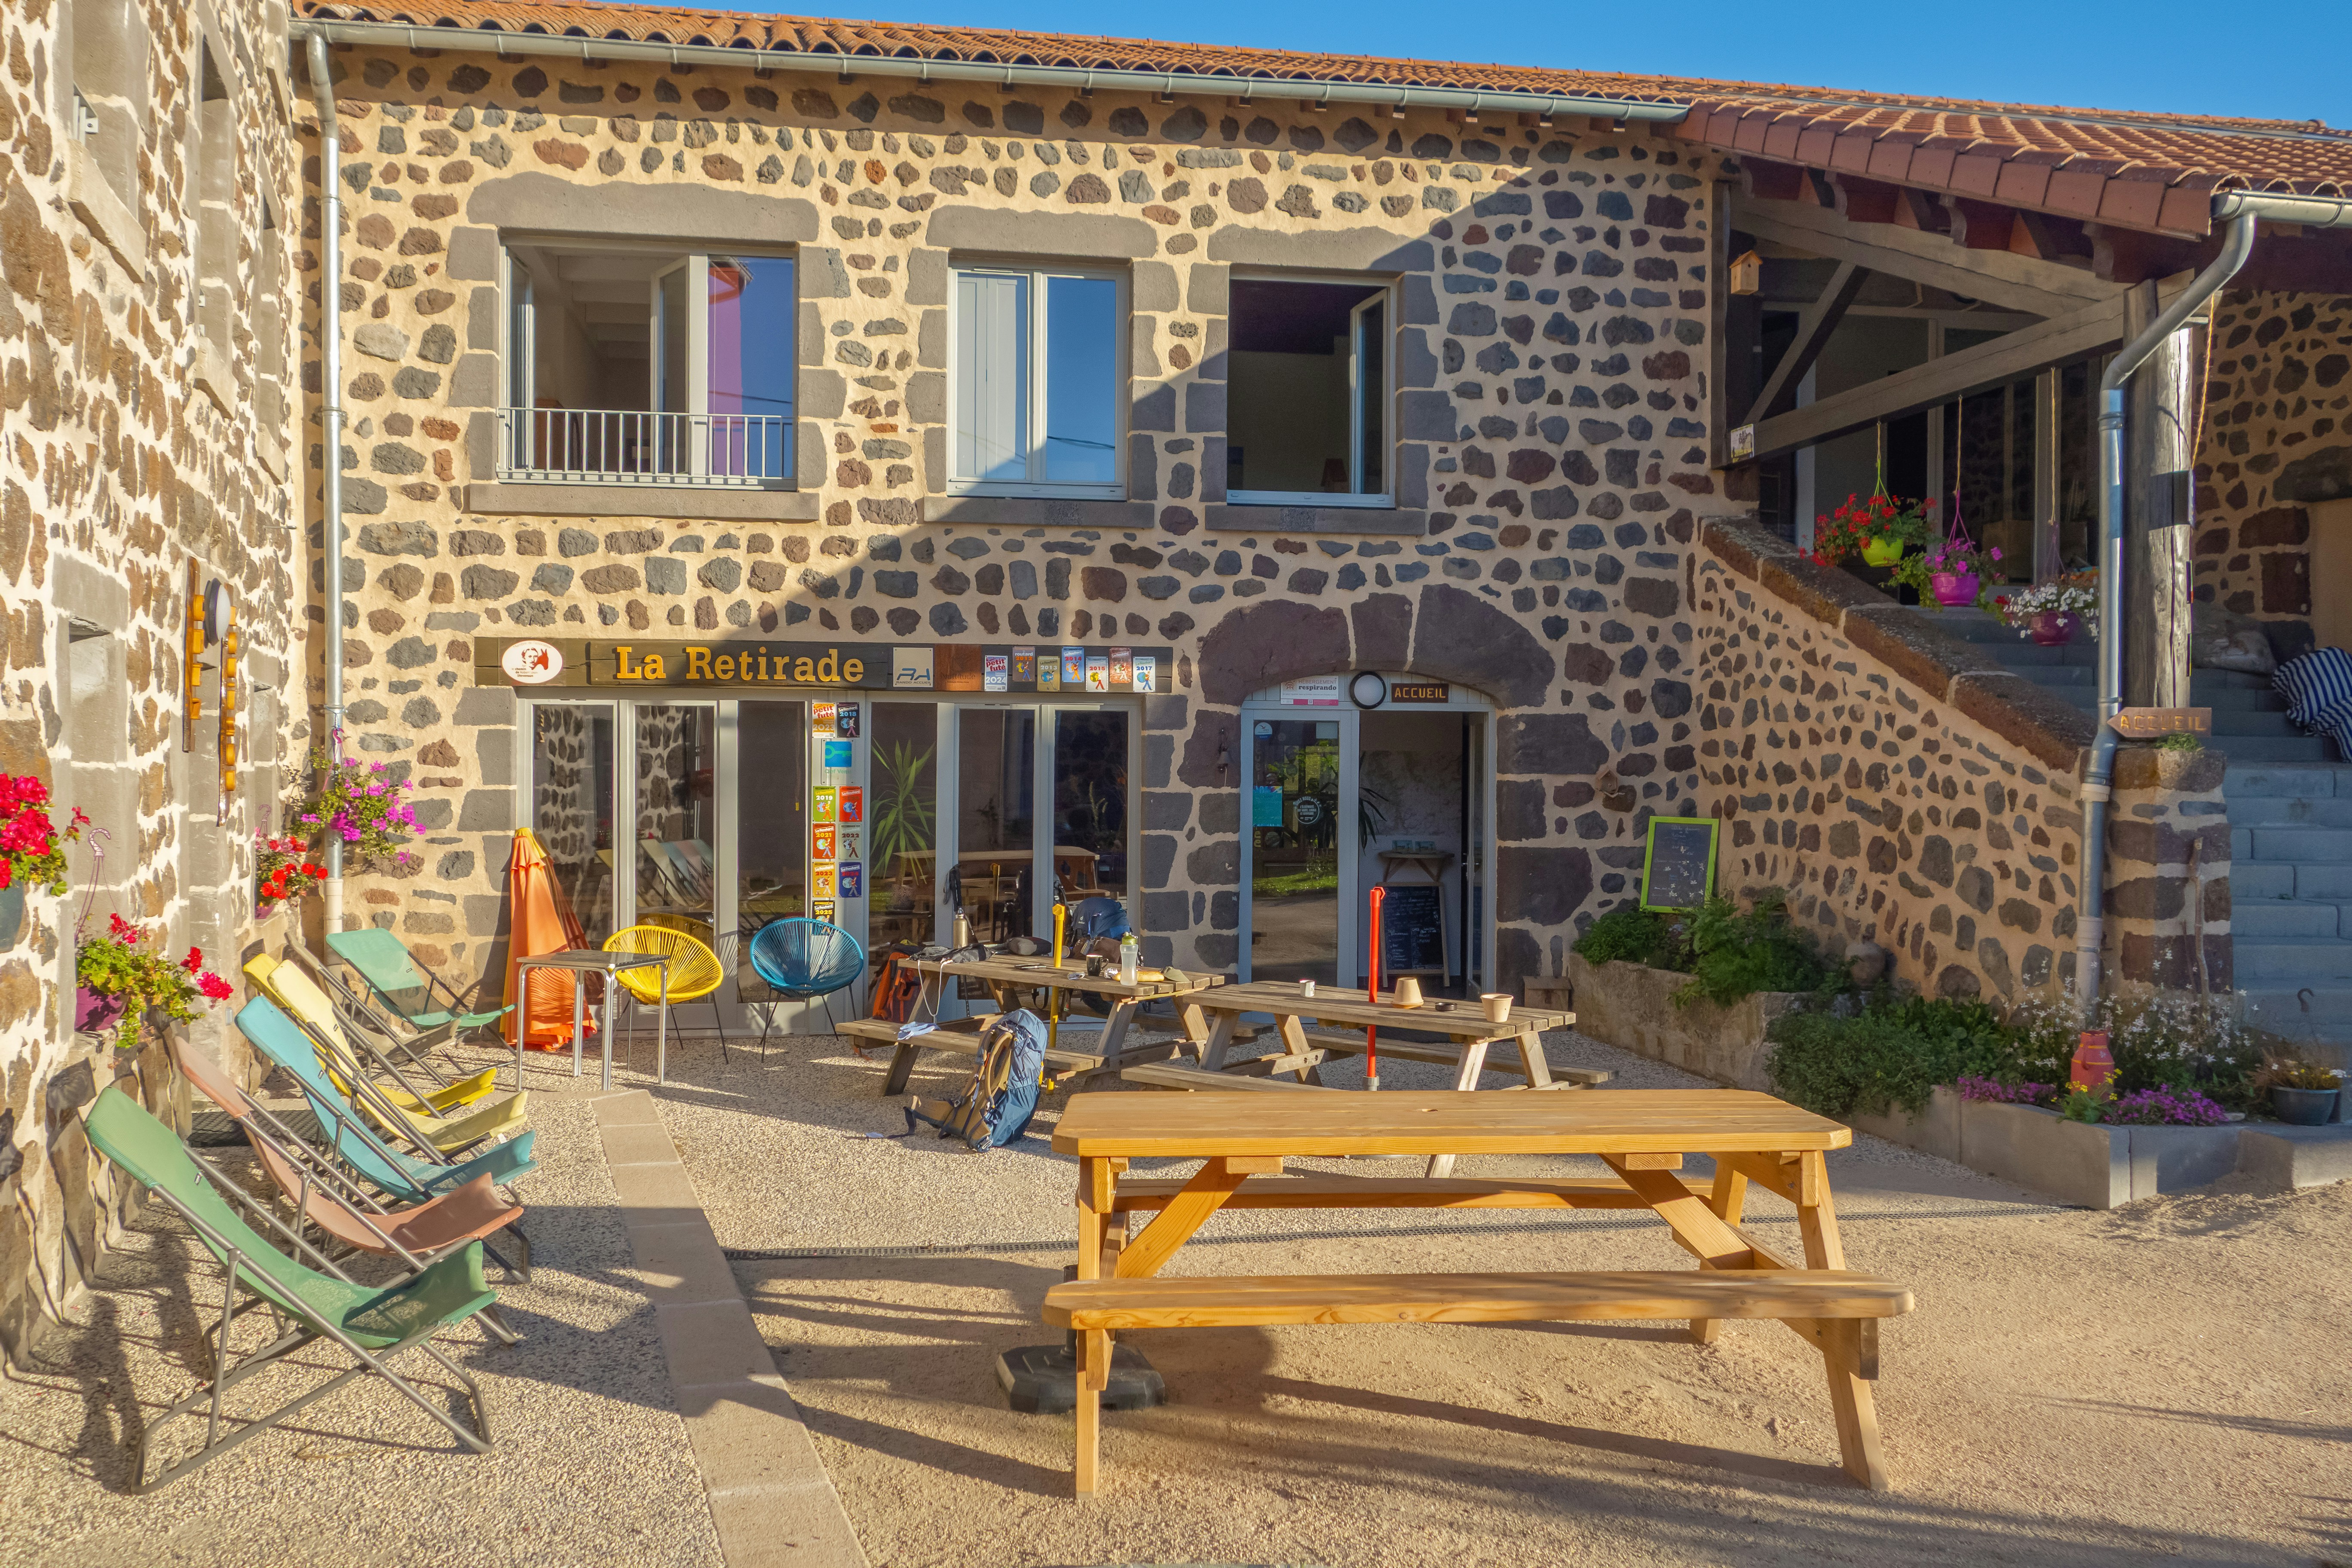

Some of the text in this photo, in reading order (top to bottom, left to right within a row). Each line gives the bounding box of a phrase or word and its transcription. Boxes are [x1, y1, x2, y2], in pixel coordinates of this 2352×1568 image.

[616, 646, 864, 682] La Retirade
[986, 658, 1005, 667] petit
[1395, 688, 1446, 698] ACCUEIL
[813, 705, 833, 714] petit
[2121, 715, 2206, 730] ACCUEIL
